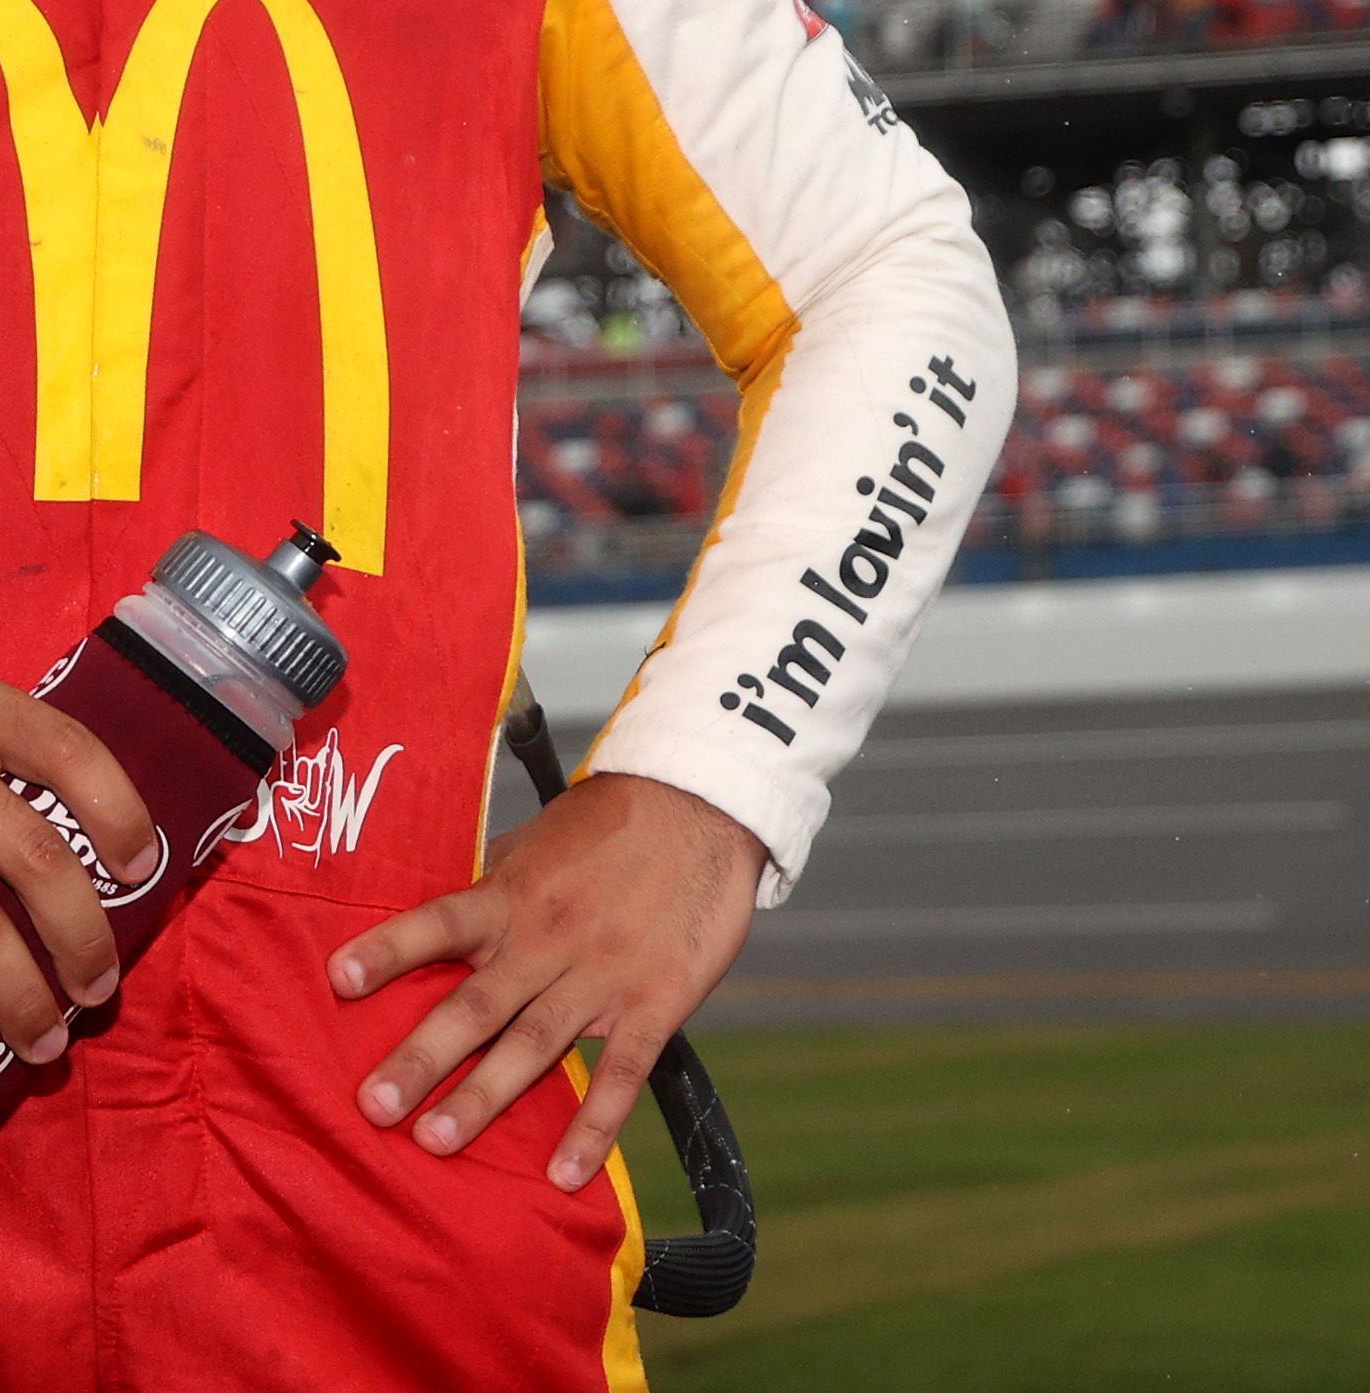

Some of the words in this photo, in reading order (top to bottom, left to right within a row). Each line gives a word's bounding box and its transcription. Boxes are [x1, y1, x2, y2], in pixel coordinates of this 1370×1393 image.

[720, 618, 846, 747] i'm
[800, 410, 945, 626] lovin'
[909, 353, 978, 430] it
